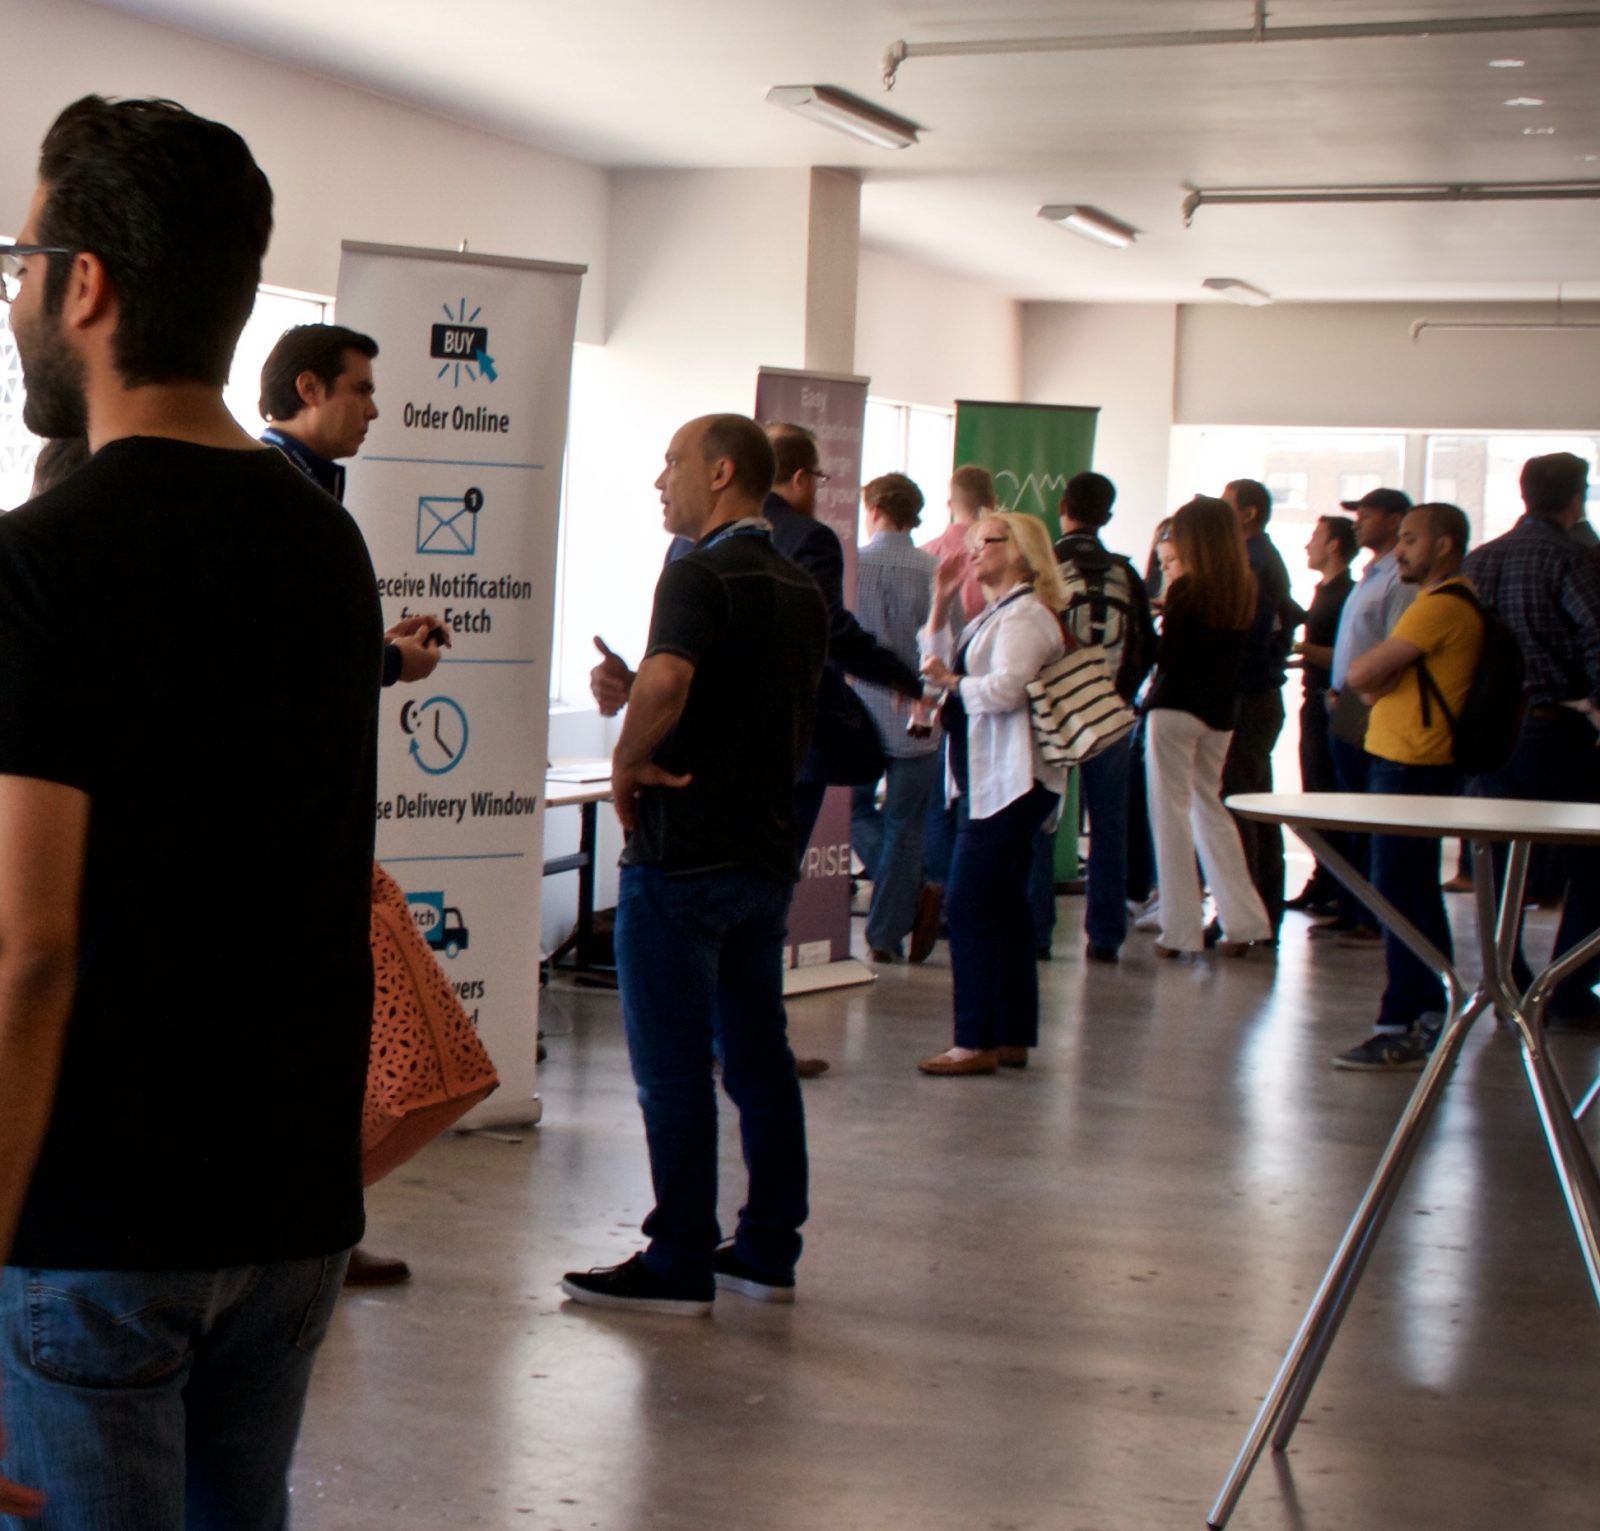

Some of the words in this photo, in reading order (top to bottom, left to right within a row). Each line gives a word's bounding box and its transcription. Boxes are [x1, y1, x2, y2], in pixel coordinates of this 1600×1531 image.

[444, 330, 475, 354] BUY
[802, 387, 828, 412] Easy
[404, 402, 448, 429] Order
[452, 405, 510, 433] Online
[378, 572, 425, 598] eceive
[429, 572, 532, 600] Notification
[444, 607, 491, 633] Fetch
[396, 793, 467, 824] Delivery
[471, 791, 536, 817] Window
[413, 910, 435, 926] tch
